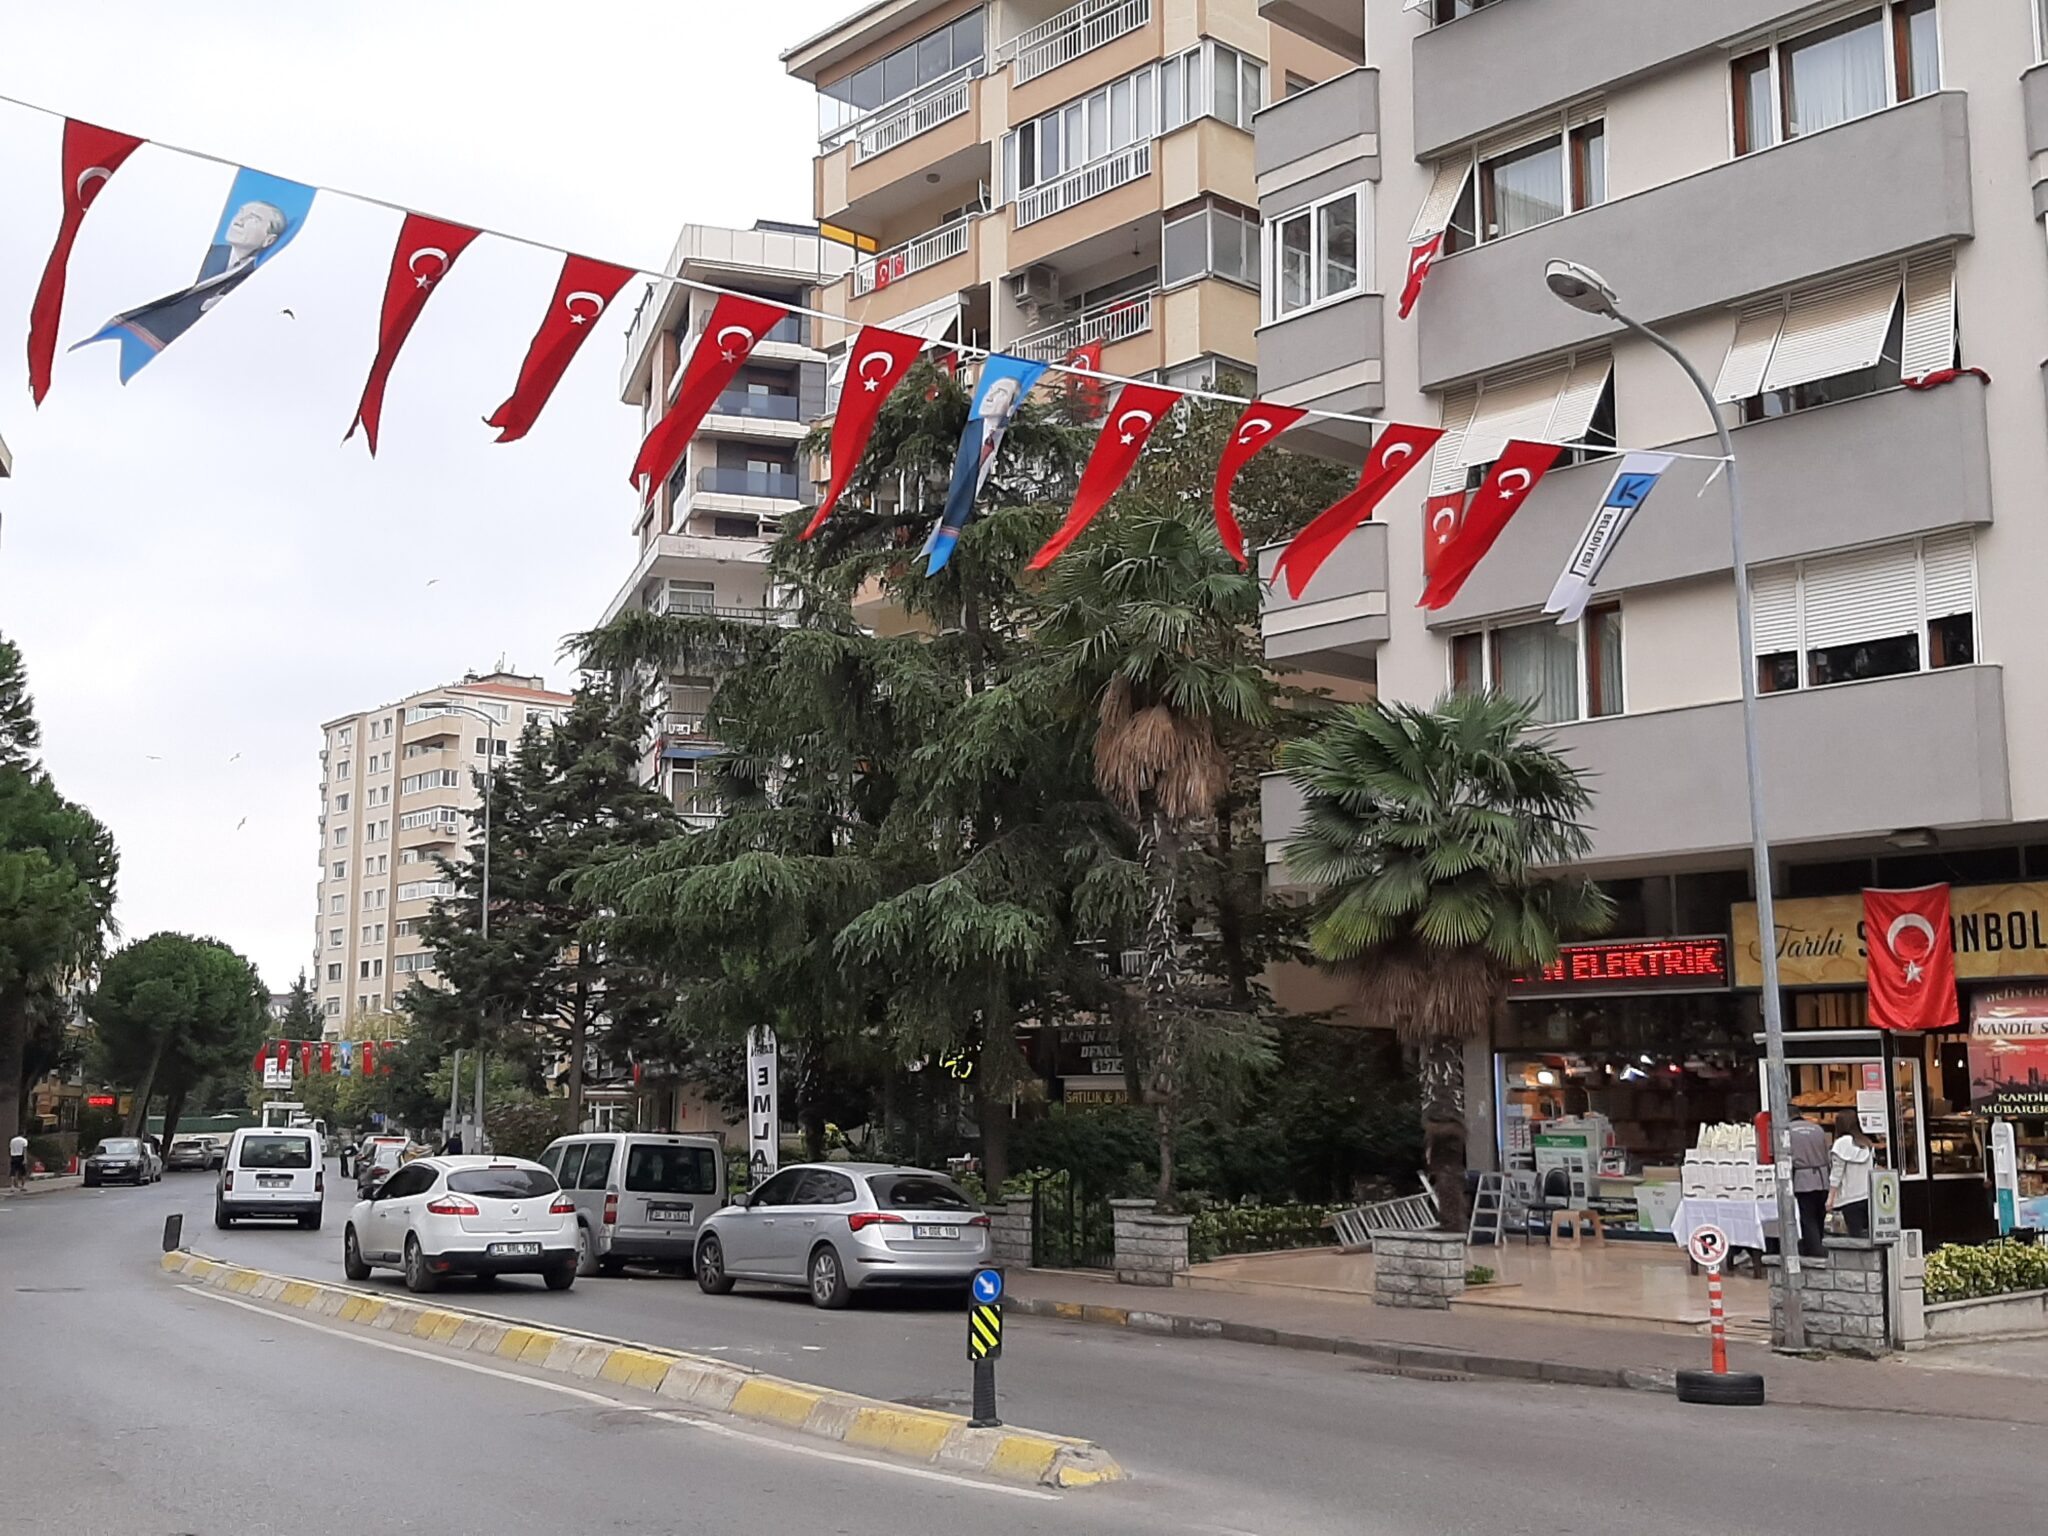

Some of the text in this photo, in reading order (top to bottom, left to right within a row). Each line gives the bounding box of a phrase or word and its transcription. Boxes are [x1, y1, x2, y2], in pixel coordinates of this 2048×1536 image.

[1750, 924, 1844, 962] Tarihi
[1572, 946, 1718, 980] ELEKTRİK
[1977, 1020, 2035, 1035] KANDİL
